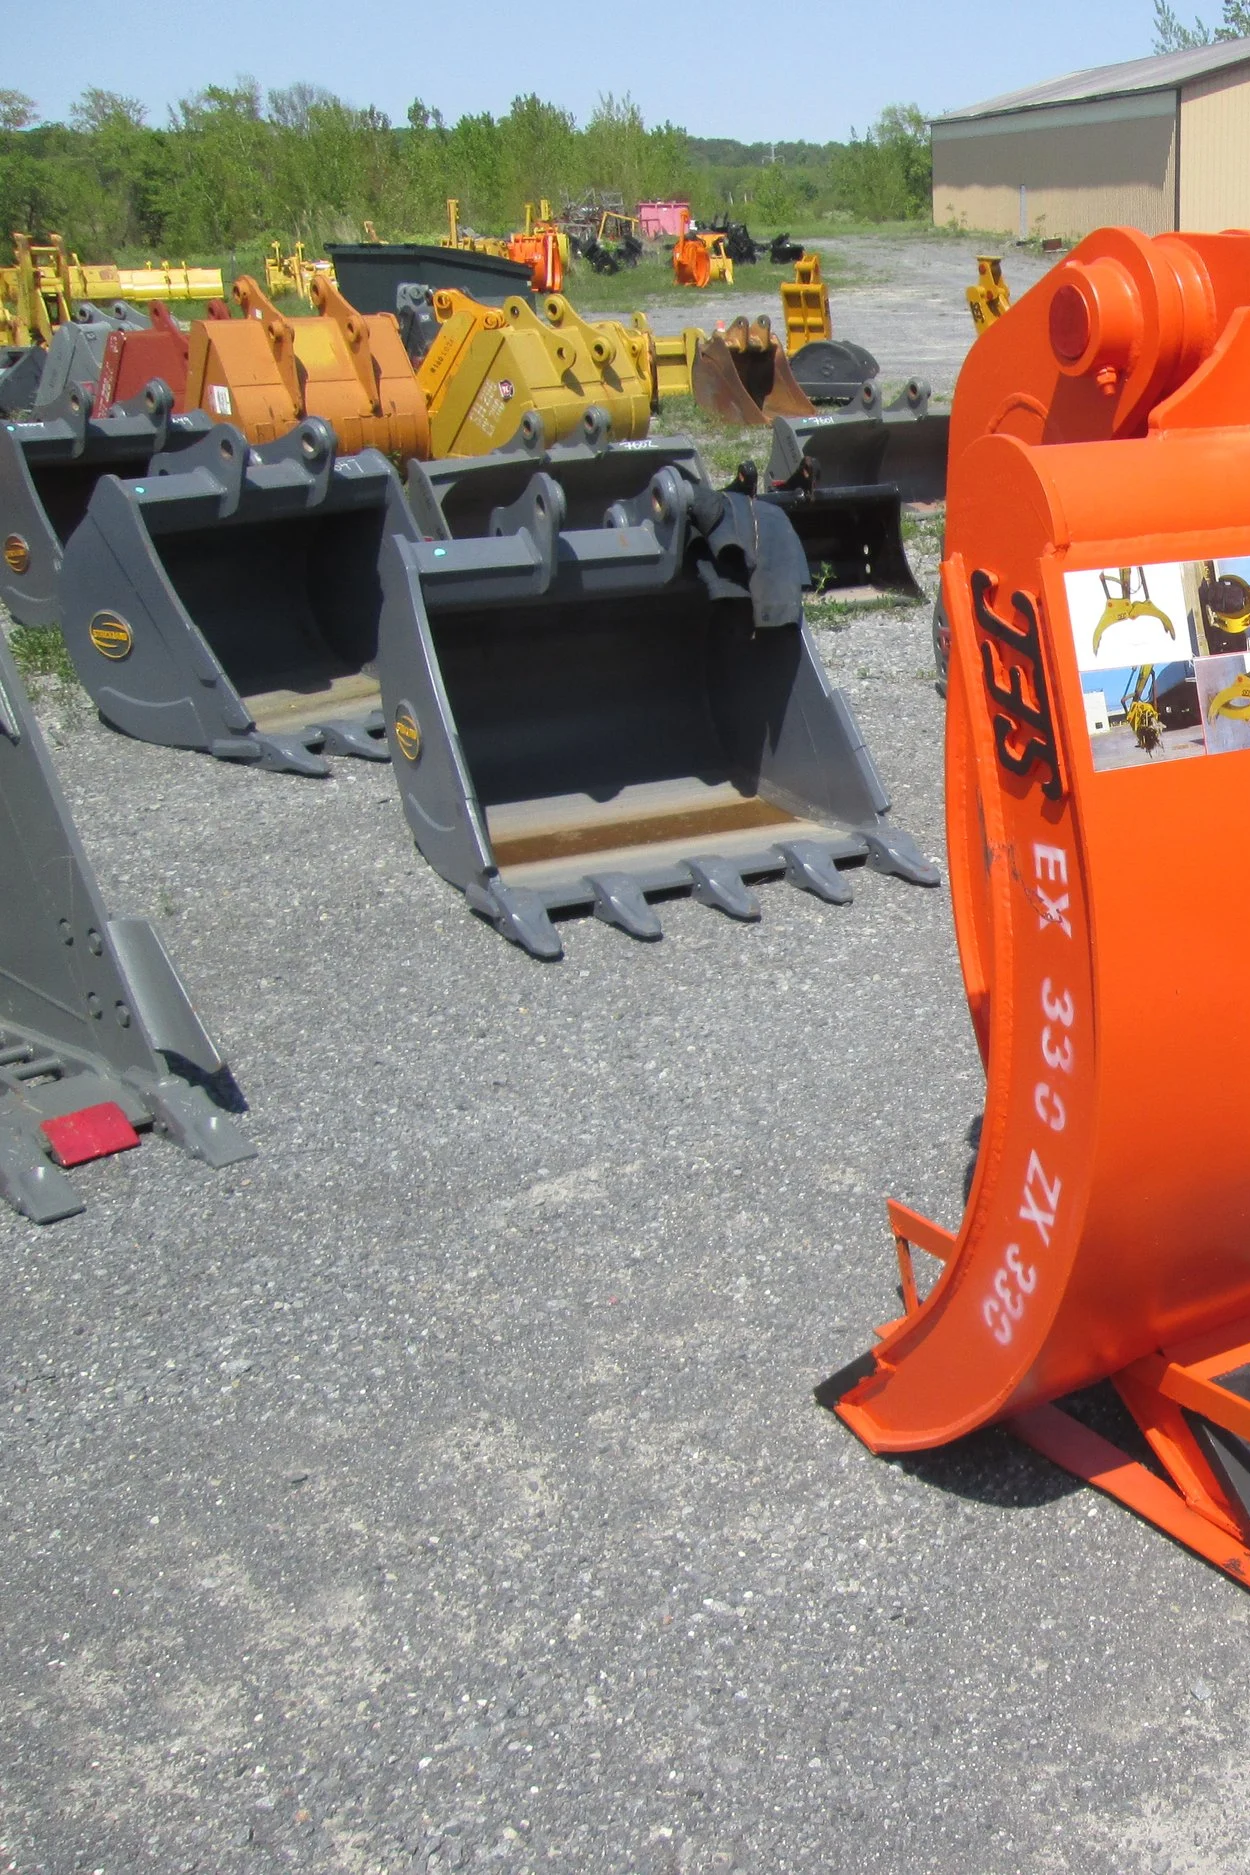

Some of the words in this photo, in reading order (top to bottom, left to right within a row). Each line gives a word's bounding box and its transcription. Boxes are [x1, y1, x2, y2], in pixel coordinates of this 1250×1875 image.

[1032, 841, 1073, 940] EX
[1035, 976, 1076, 1132] 330
[1019, 1148, 1063, 1248] ZX
